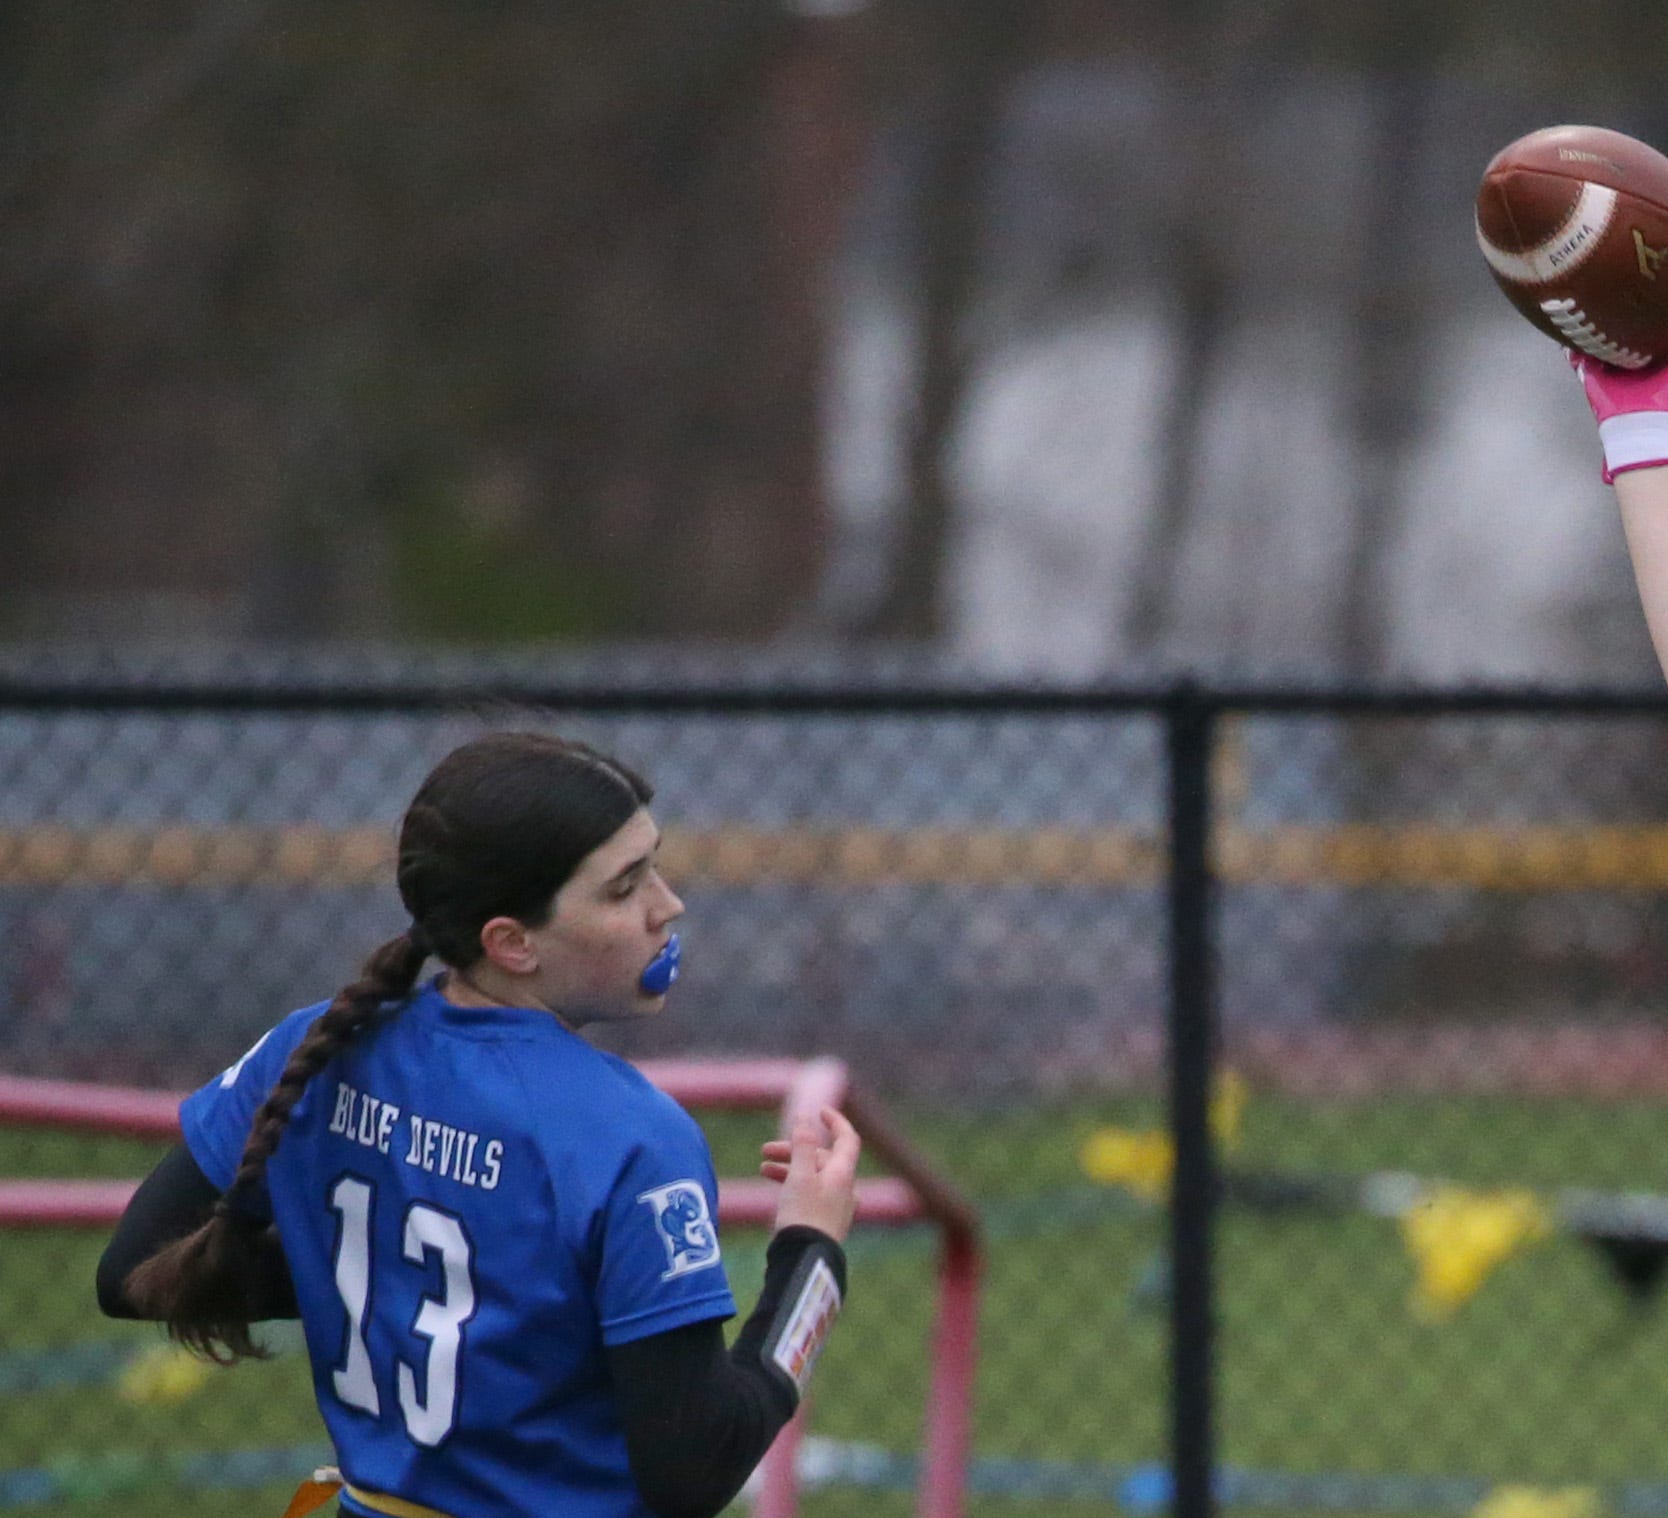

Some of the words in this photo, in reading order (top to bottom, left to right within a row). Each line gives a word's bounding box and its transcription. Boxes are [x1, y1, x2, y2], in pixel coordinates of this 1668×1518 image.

[1548, 223, 1593, 267] ATHENA
[328, 1082, 400, 1155] BLUE
[405, 1114, 504, 1190] DEVILS
[329, 1172, 476, 1449] 13
